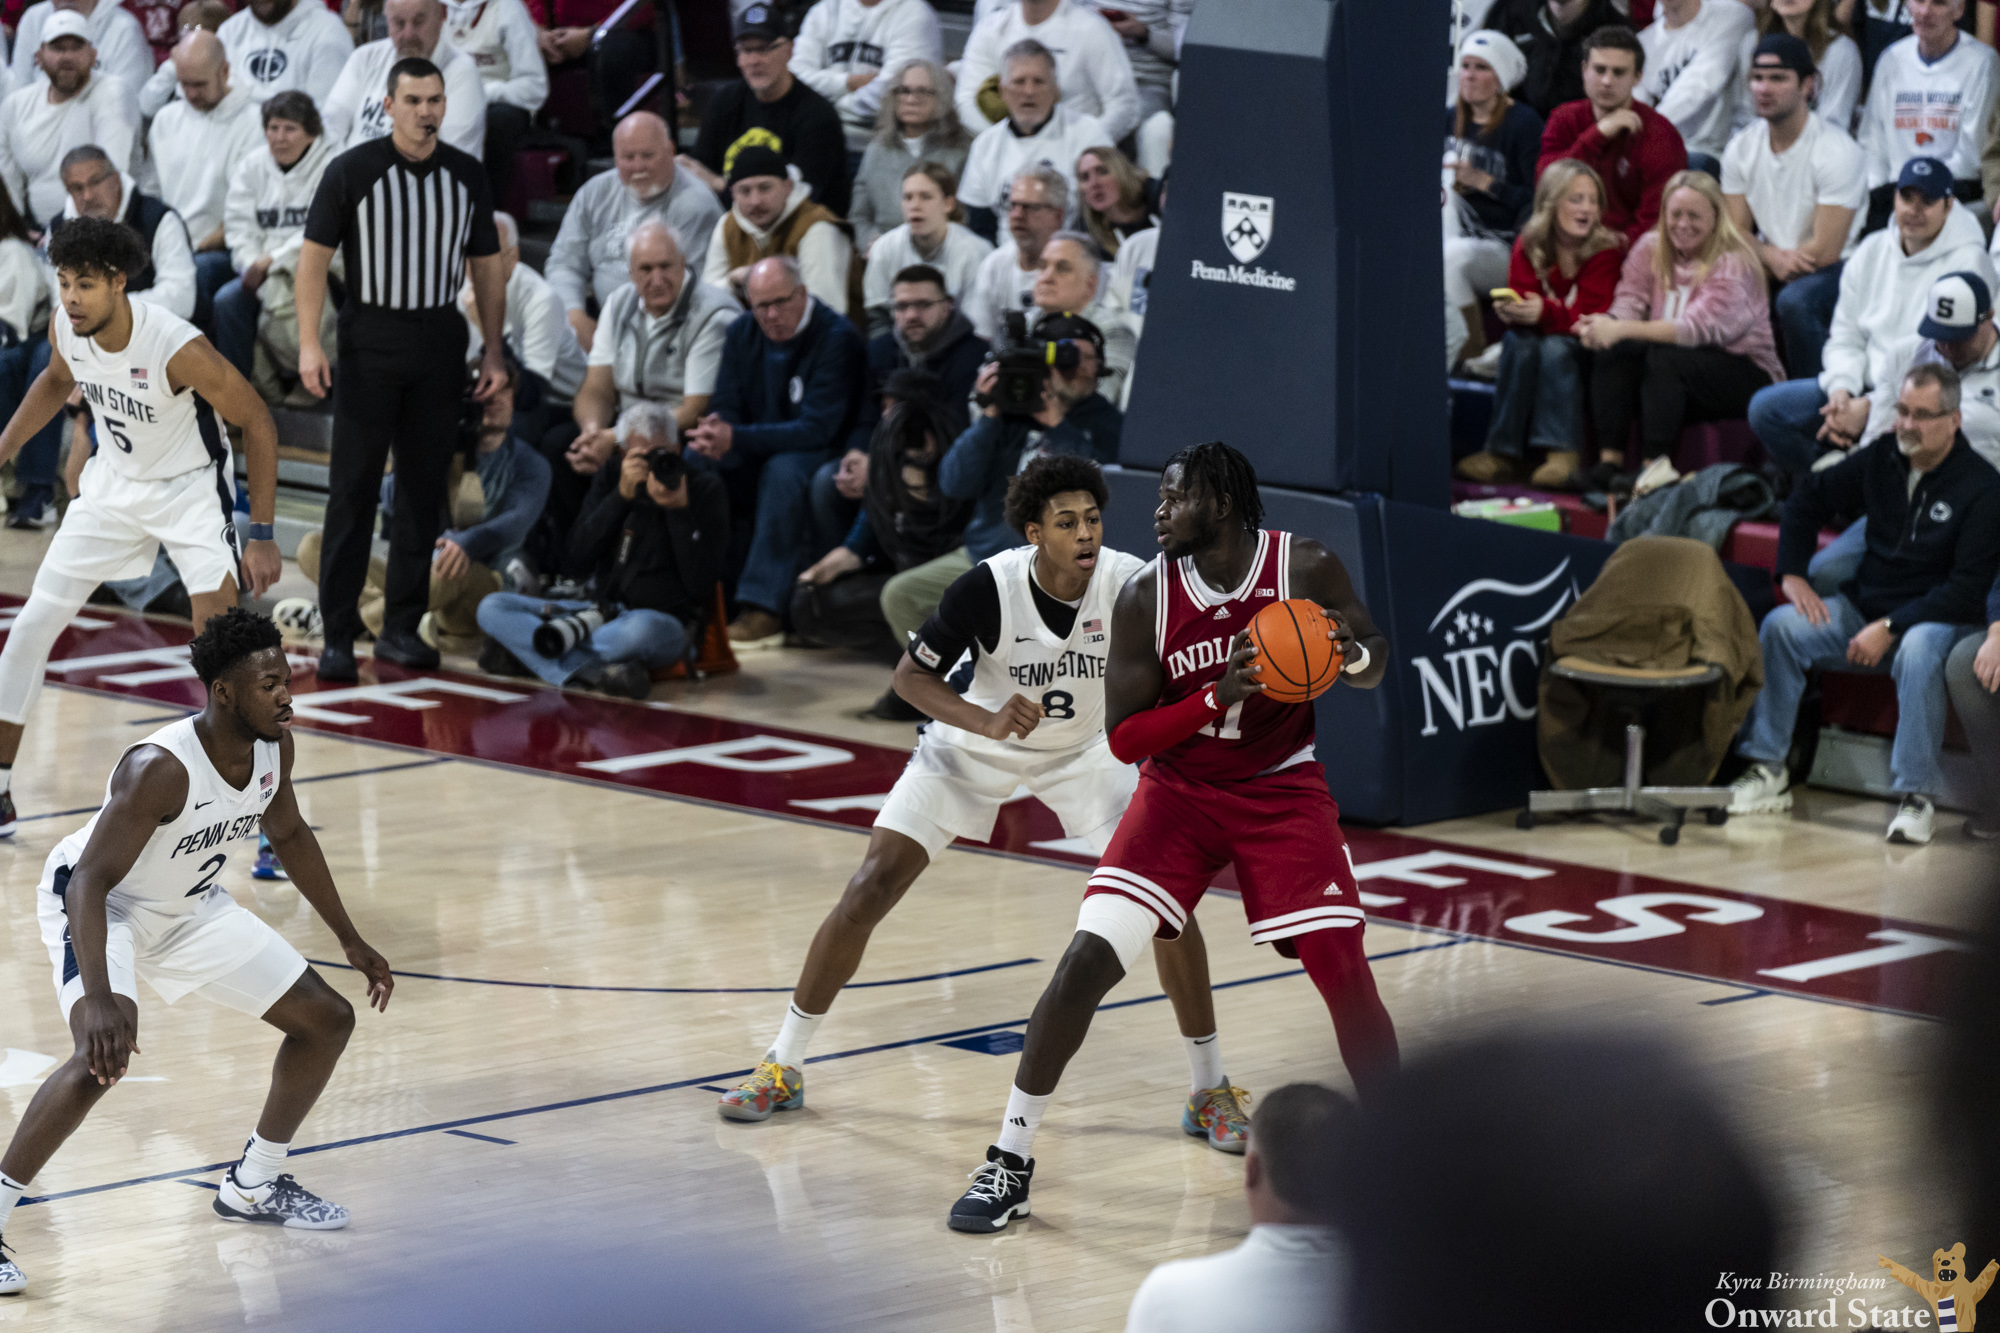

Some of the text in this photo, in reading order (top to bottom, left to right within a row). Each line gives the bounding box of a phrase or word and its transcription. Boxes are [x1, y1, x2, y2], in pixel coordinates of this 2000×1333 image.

[1190, 259, 1296, 292] Penn Medicine
[1936, 296, 1955, 319] S
[108, 387, 158, 423] STATE
[103, 415, 133, 455] 5
[1009, 650, 1106, 687] PENN STATE
[1042, 689, 1076, 720] 8
[170, 820, 230, 859] PENN
[184, 853, 227, 898] 2
